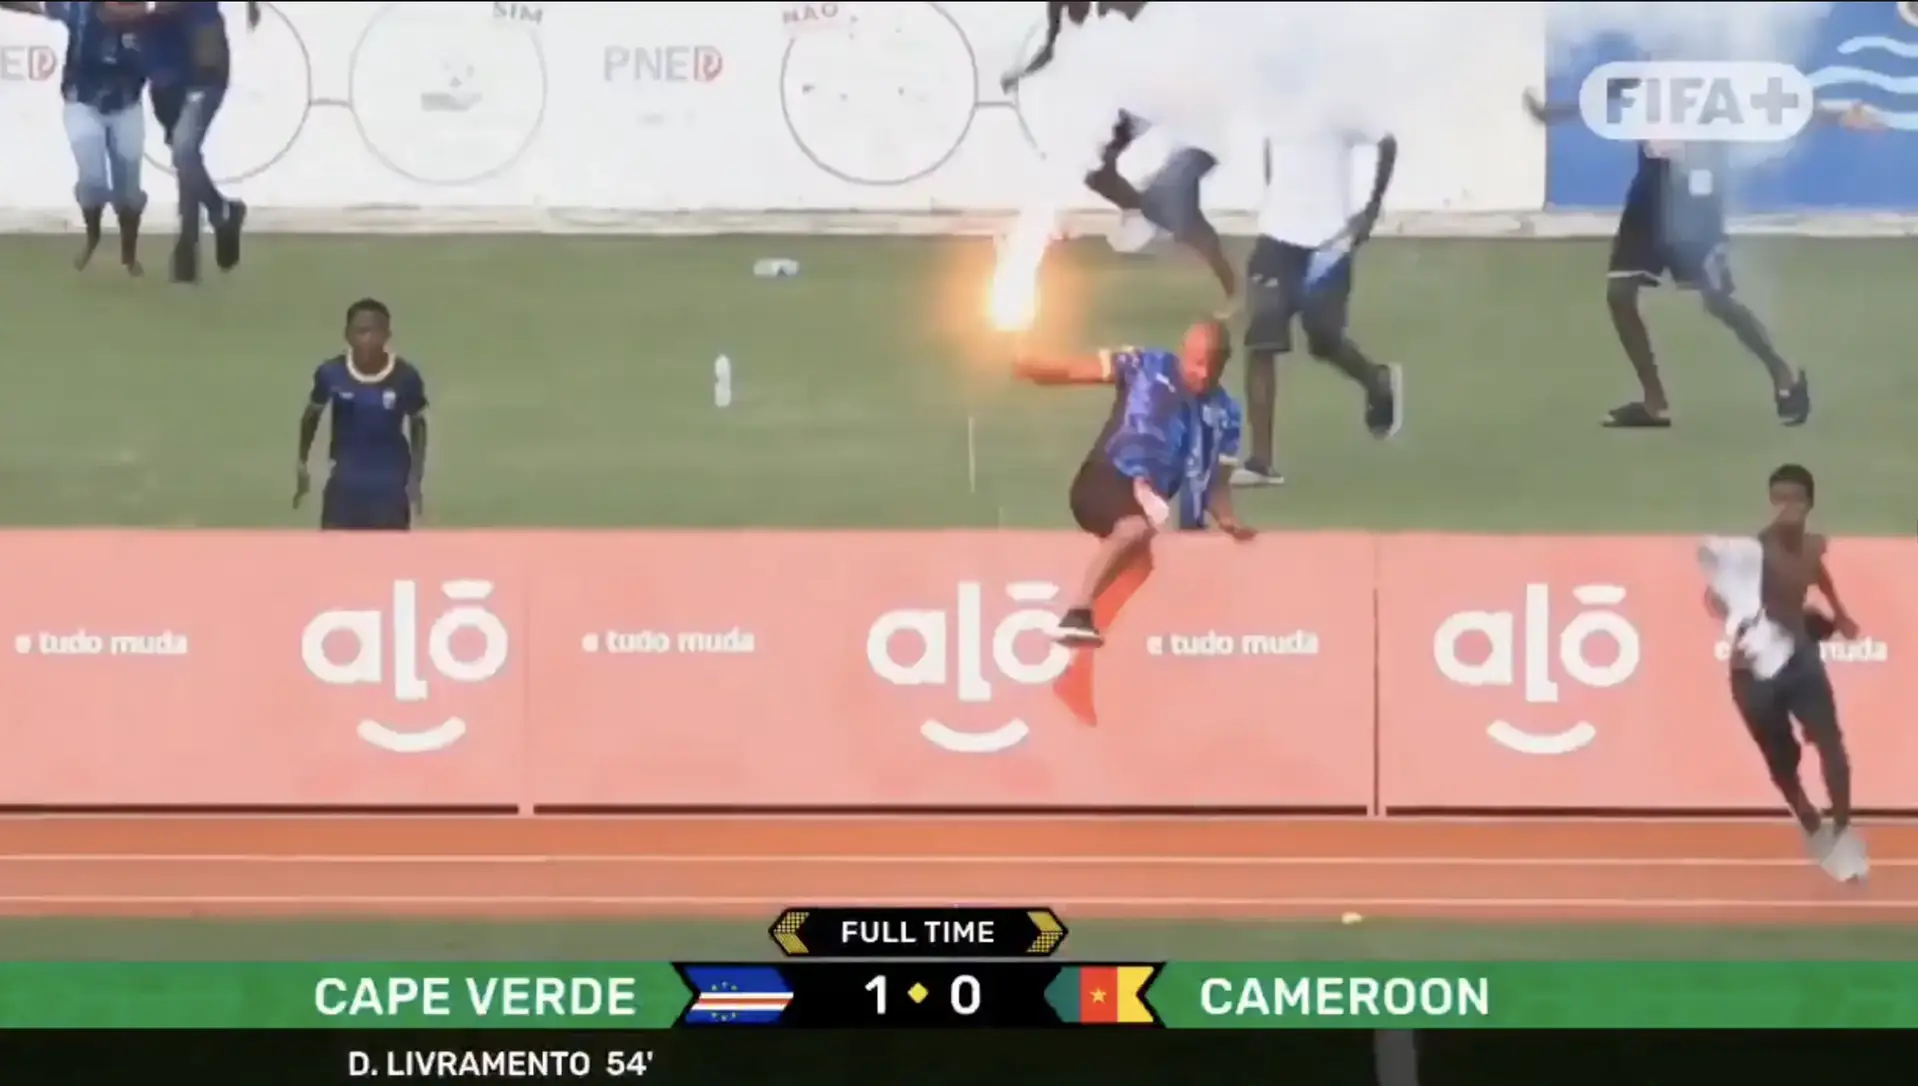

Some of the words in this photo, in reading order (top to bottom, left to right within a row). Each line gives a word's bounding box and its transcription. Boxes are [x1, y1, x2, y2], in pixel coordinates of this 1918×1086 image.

[604, 45, 724, 81] PNED
[38, 629, 104, 655] tudo
[109, 628, 189, 656] muda
[606, 628, 671, 654] tudo
[677, 626, 756, 654] muda
[1170, 629, 1234, 656] tudo
[1241, 628, 1320, 656] muda
